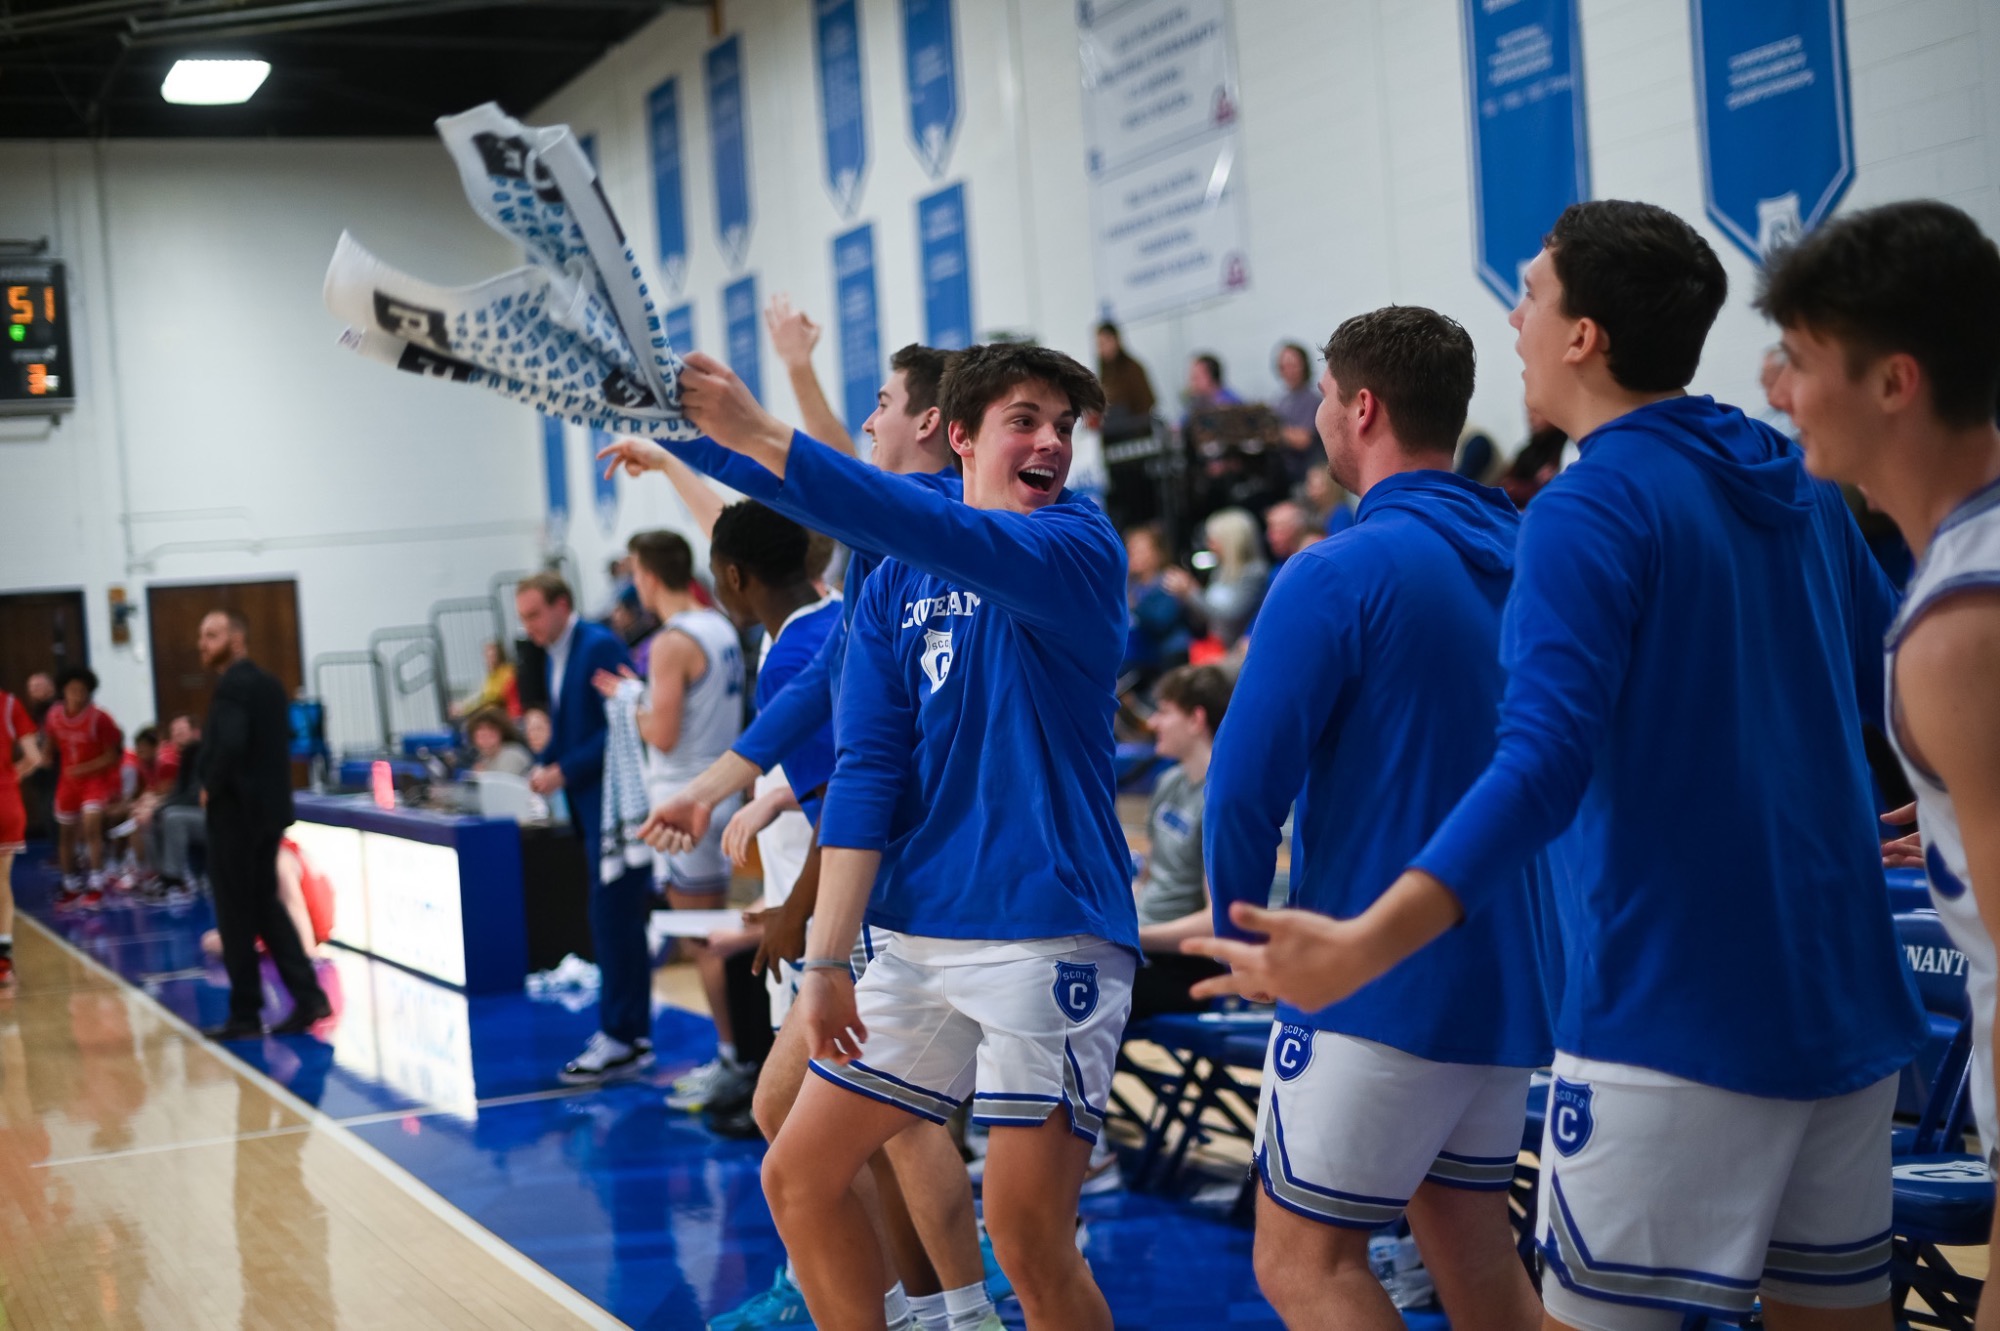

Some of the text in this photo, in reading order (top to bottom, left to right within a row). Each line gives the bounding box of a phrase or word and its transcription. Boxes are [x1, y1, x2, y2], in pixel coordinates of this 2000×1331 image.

[7, 286, 56, 324] 51
[935, 652, 950, 682] C
[1903, 944, 1969, 976] NANT
[1062, 970, 1092, 983] SCOTS
[1069, 982, 1088, 1010] C
[1283, 1024, 1309, 1042] SCOTS
[1280, 1038, 1301, 1069] C
[1555, 1090, 1585, 1108] SCOTS
[1558, 1106, 1578, 1142] C
